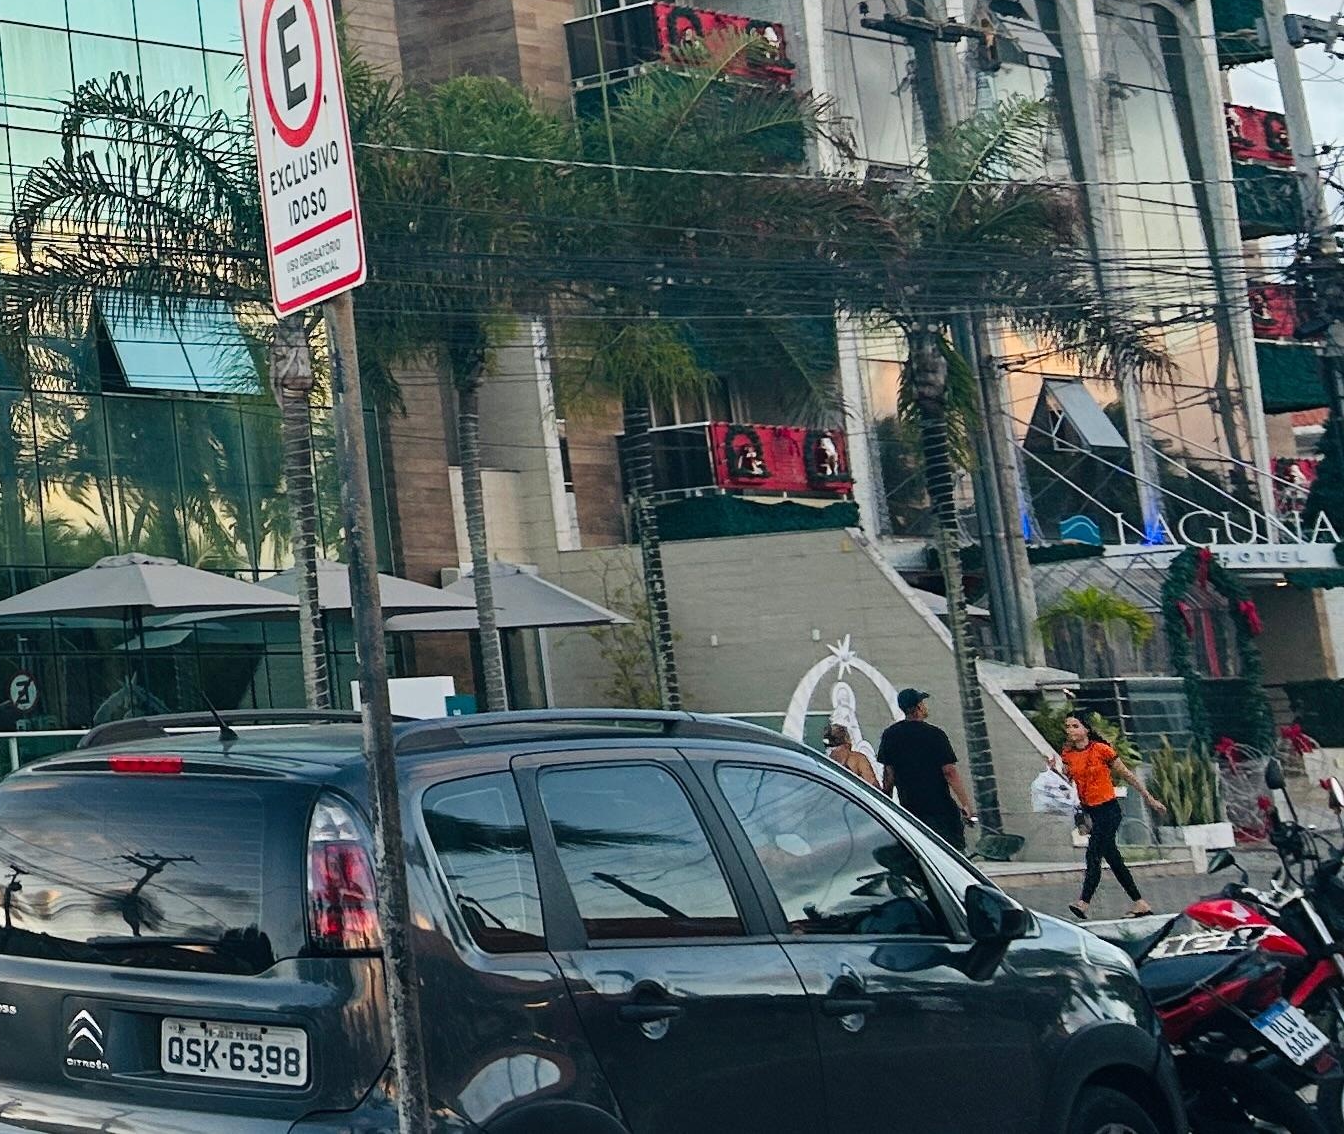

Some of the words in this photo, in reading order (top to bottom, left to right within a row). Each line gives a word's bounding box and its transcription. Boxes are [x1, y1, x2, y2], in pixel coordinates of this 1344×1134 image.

[277, 5, 307, 110] E
[270, 140, 339, 197] EXCLUSIVO
[288, 187, 327, 227] IDOSO
[1112, 510, 1342, 547] LAGUNA
